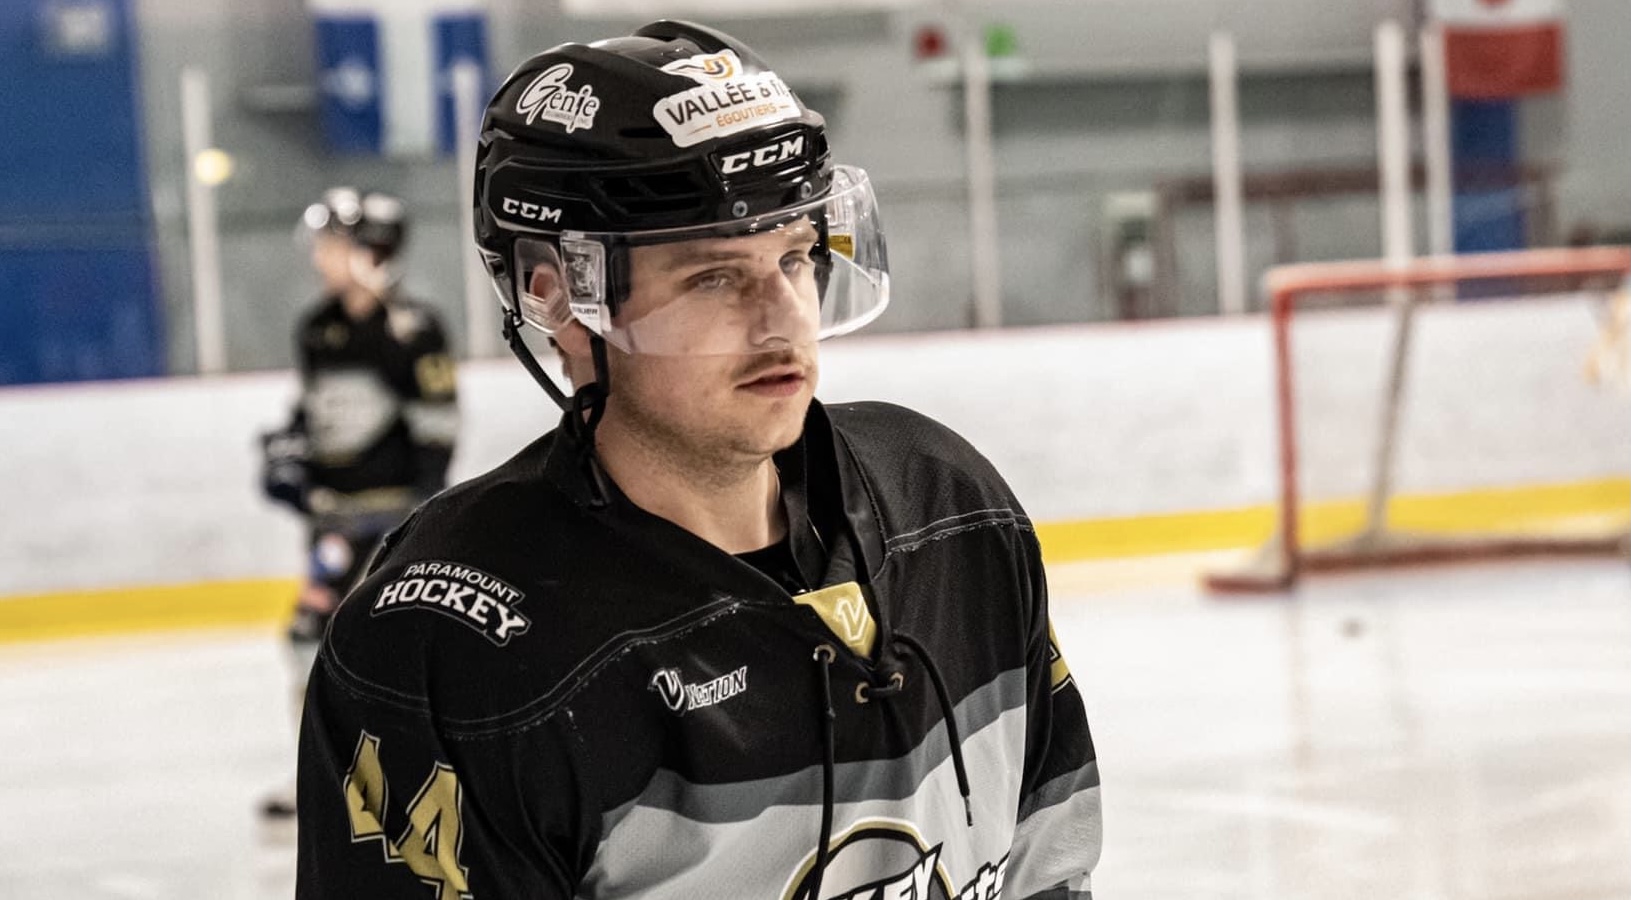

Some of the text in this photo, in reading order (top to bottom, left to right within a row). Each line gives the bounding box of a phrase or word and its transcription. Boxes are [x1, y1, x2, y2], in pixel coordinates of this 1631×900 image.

[517, 64, 599, 132] Genie
[665, 82, 756, 126] VALLÉE
[715, 102, 778, 127] ÉGOUTIERS
[721, 135, 804, 174] CCM
[502, 196, 562, 223] CCM
[403, 562, 519, 603] PARAMOUNT
[374, 577, 526, 639] HOCKEY
